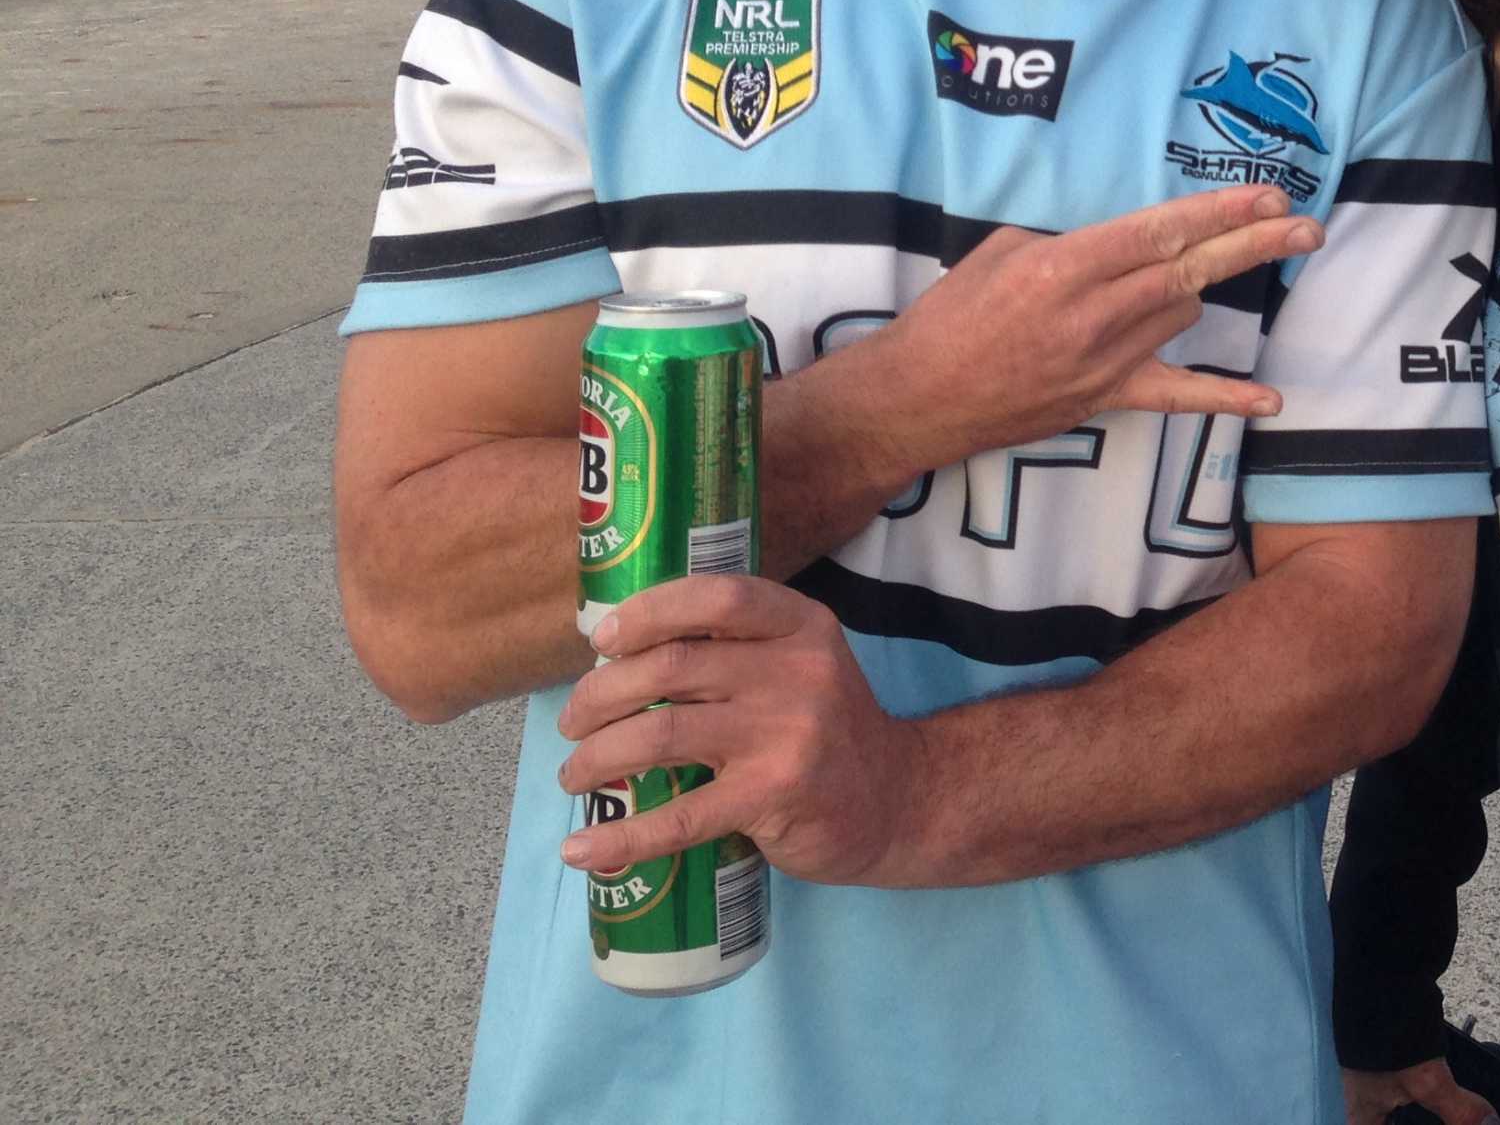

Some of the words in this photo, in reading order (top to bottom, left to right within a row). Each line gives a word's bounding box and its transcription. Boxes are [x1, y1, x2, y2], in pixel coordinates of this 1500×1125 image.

[722, 30, 785, 44] TELSTRA
[705, 41, 800, 56] PREMIERSHIP
[1165, 141, 1322, 197] SHARKS
[1181, 166, 1242, 183] CRONULLA
